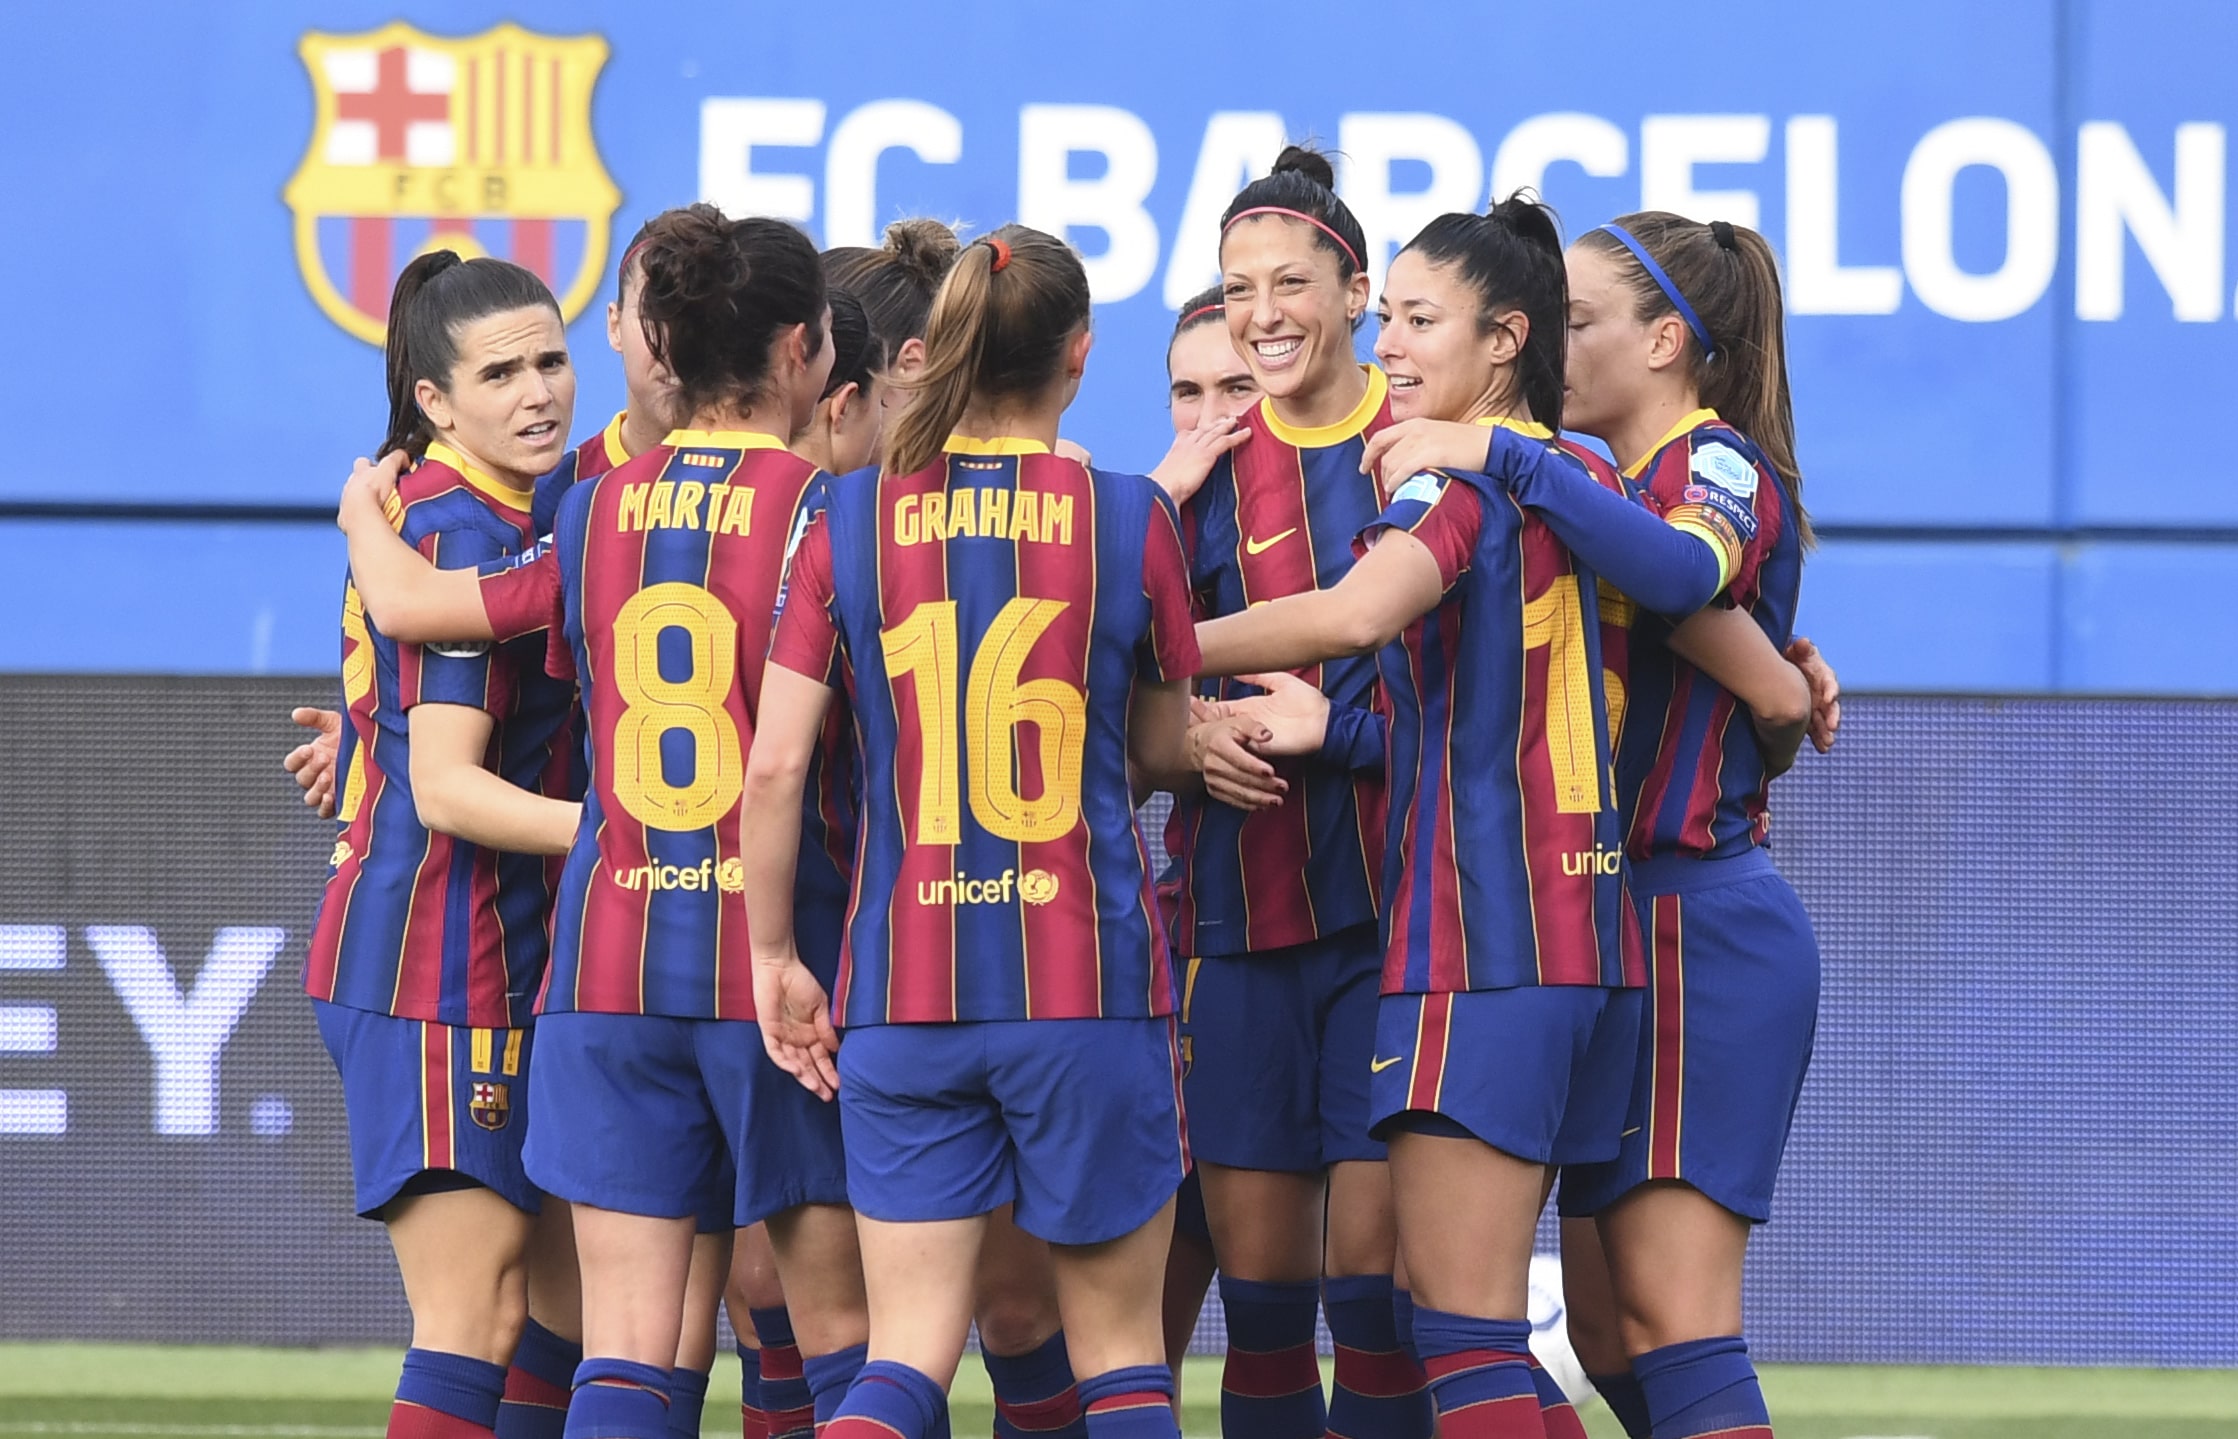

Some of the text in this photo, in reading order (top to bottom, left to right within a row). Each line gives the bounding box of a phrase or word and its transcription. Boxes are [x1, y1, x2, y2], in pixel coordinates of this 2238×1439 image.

[392, 174, 511, 213] FCB
[699, 97, 2238, 322] FC BARCELON
[617, 481, 755, 536] MARTA
[894, 487, 1074, 546] GRAHAM
[1709, 490, 1757, 533] RESPECT
[612, 582, 744, 832] 8
[880, 597, 1089, 845] 16
[613, 857, 713, 892] unicef
[1561, 841, 1623, 876] unic
[917, 869, 1014, 905] unicef
